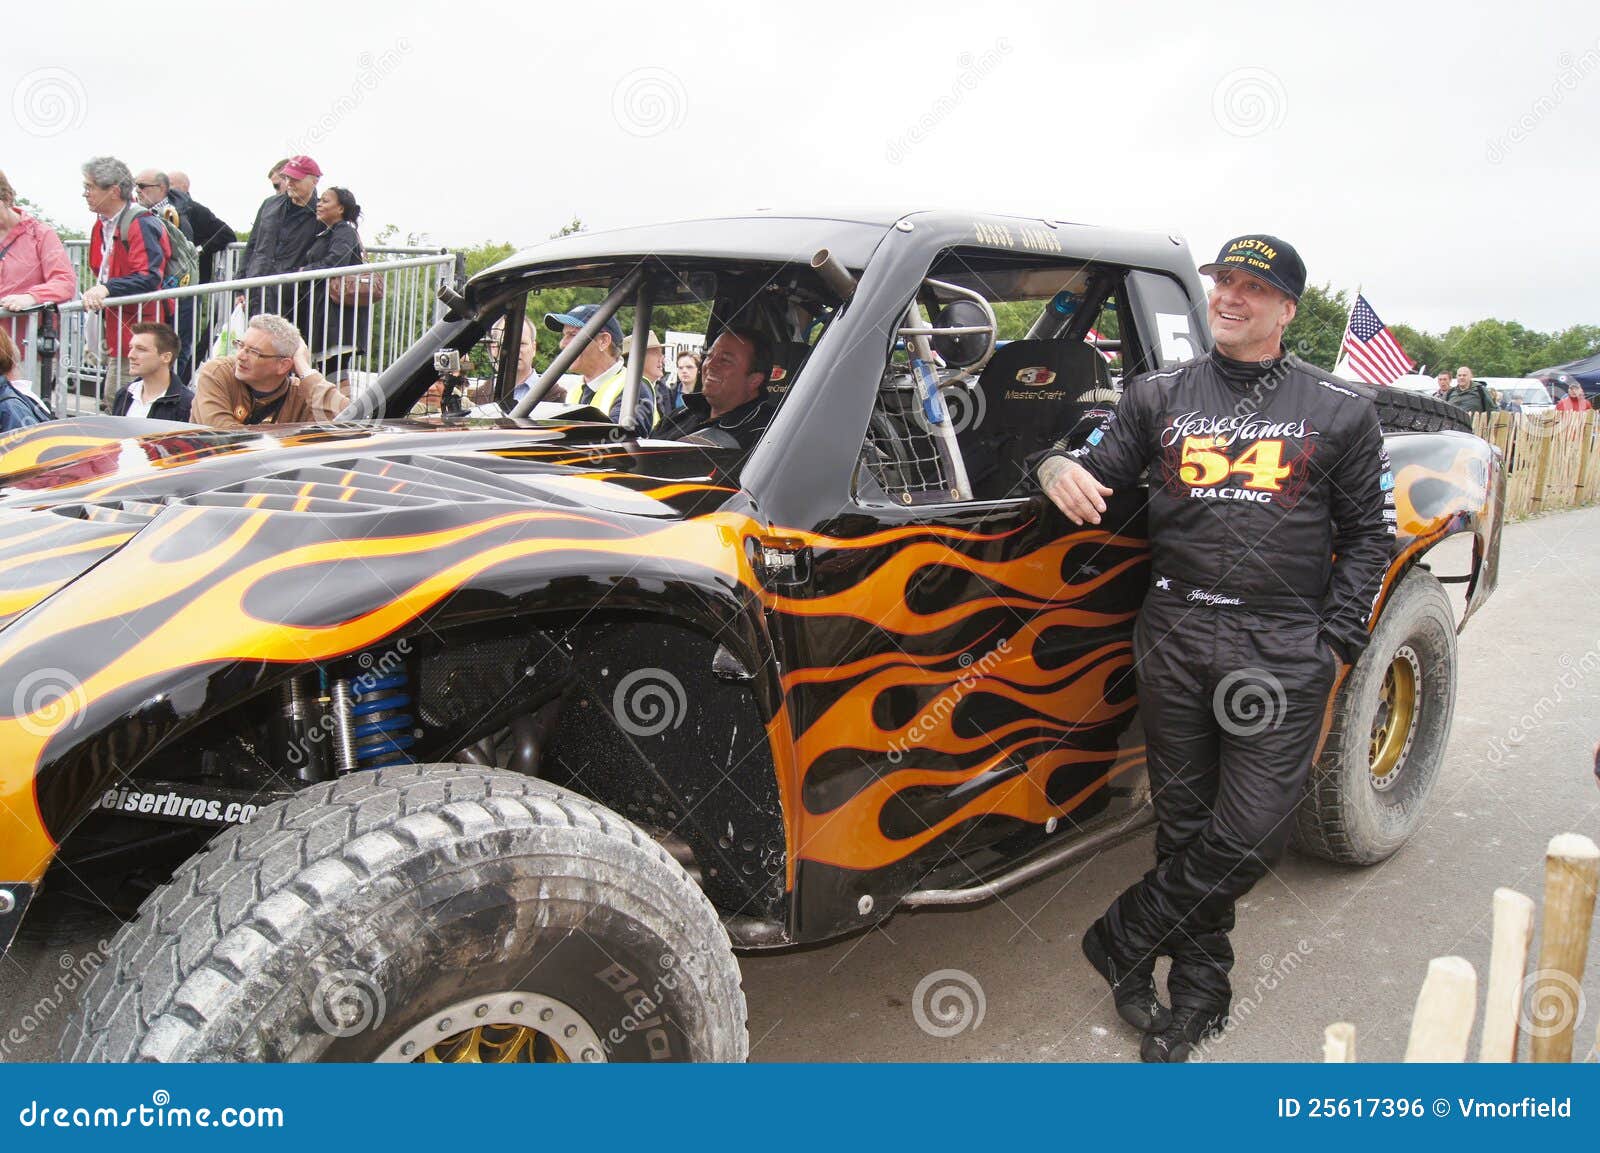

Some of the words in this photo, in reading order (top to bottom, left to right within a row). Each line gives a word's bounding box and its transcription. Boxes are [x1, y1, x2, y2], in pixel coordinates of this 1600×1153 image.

[975, 222, 1014, 248] JESSE
[1020, 224, 1062, 253] JAMES
[1228, 239, 1278, 261] AUSTIN
[1223, 255, 1245, 263] SPEED
[1247, 258, 1271, 271] SHOP
[1005, 390, 1065, 400] MasterCraft
[1161, 410, 1231, 448] Jesse
[1214, 411, 1320, 447] James
[1179, 434, 1293, 492] 54
[1190, 486, 1273, 503] RACING
[91, 786, 264, 824] eiserbros.co
